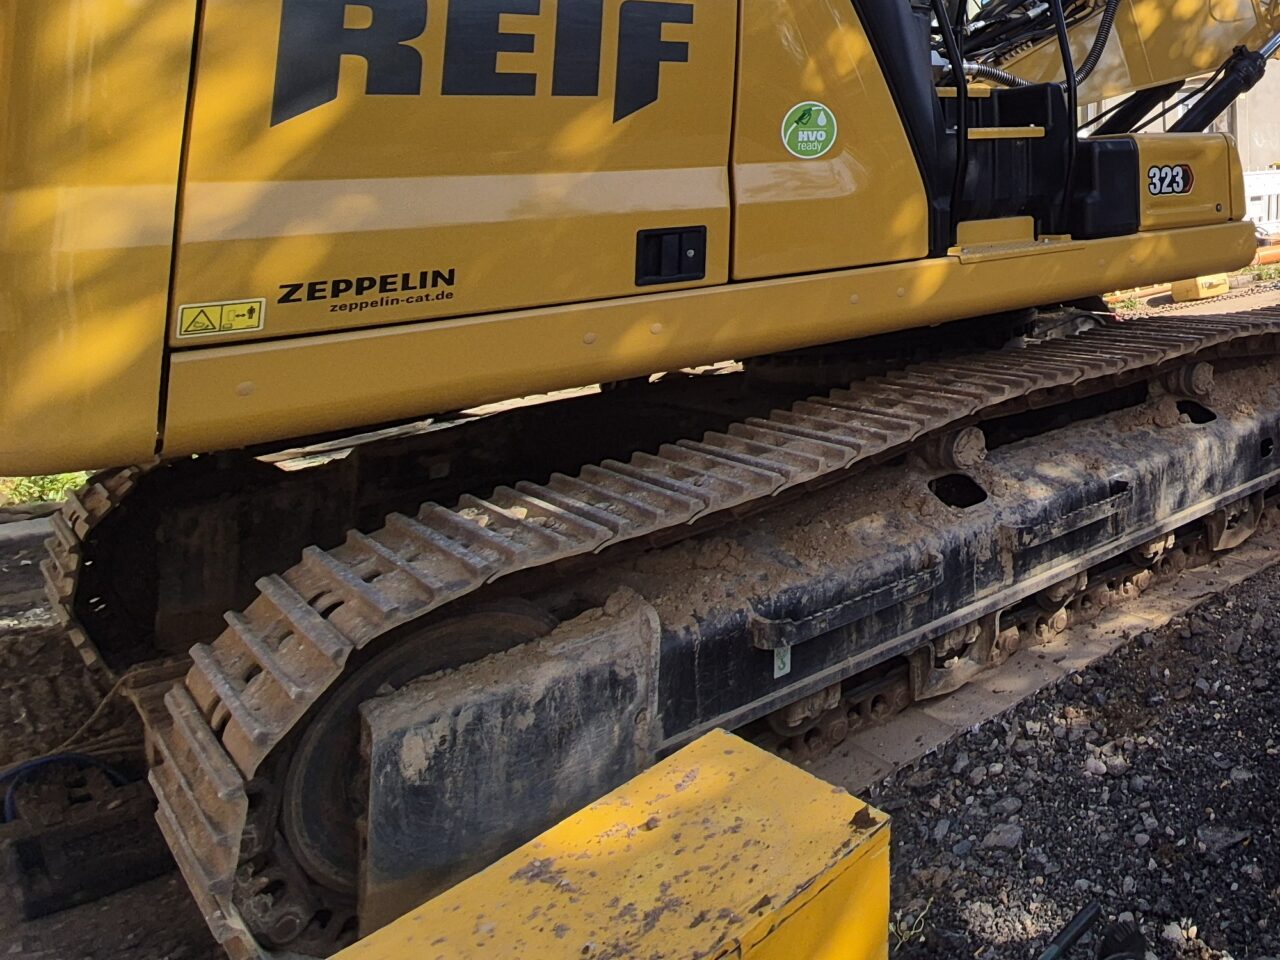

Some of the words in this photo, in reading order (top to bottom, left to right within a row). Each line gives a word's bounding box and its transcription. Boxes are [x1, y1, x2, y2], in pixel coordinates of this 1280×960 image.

[797, 130, 826, 141] HVO
[797, 140, 822, 152] ready
[1148, 165, 1184, 194] 323
[277, 268, 456, 304] ZEPPELIN
[329, 290, 454, 312] zeppelin-cat.de
